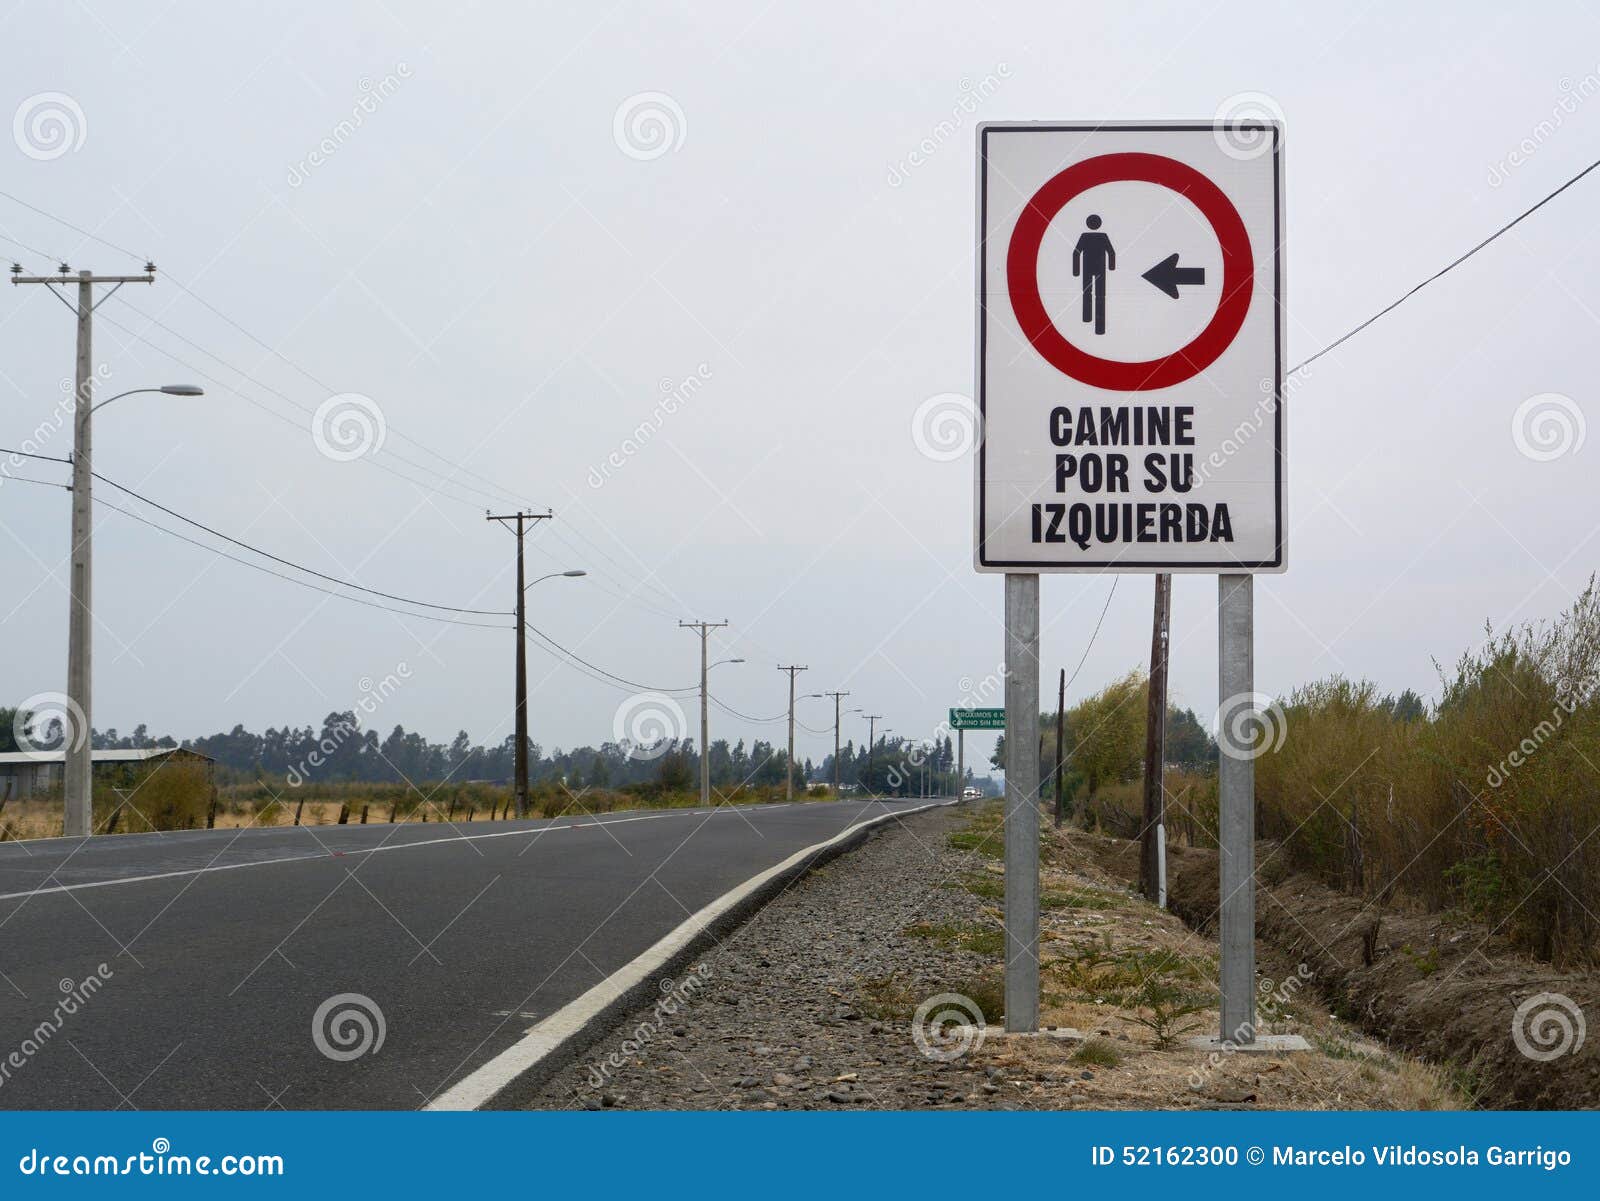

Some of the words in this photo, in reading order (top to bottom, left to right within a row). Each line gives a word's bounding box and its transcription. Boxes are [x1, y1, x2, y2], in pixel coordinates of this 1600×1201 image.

[1049, 406, 1195, 447] CAMINE
[1055, 453, 1130, 493] POR
[1143, 452, 1194, 494] SU
[1031, 503, 1234, 551] IZQUIERDA
